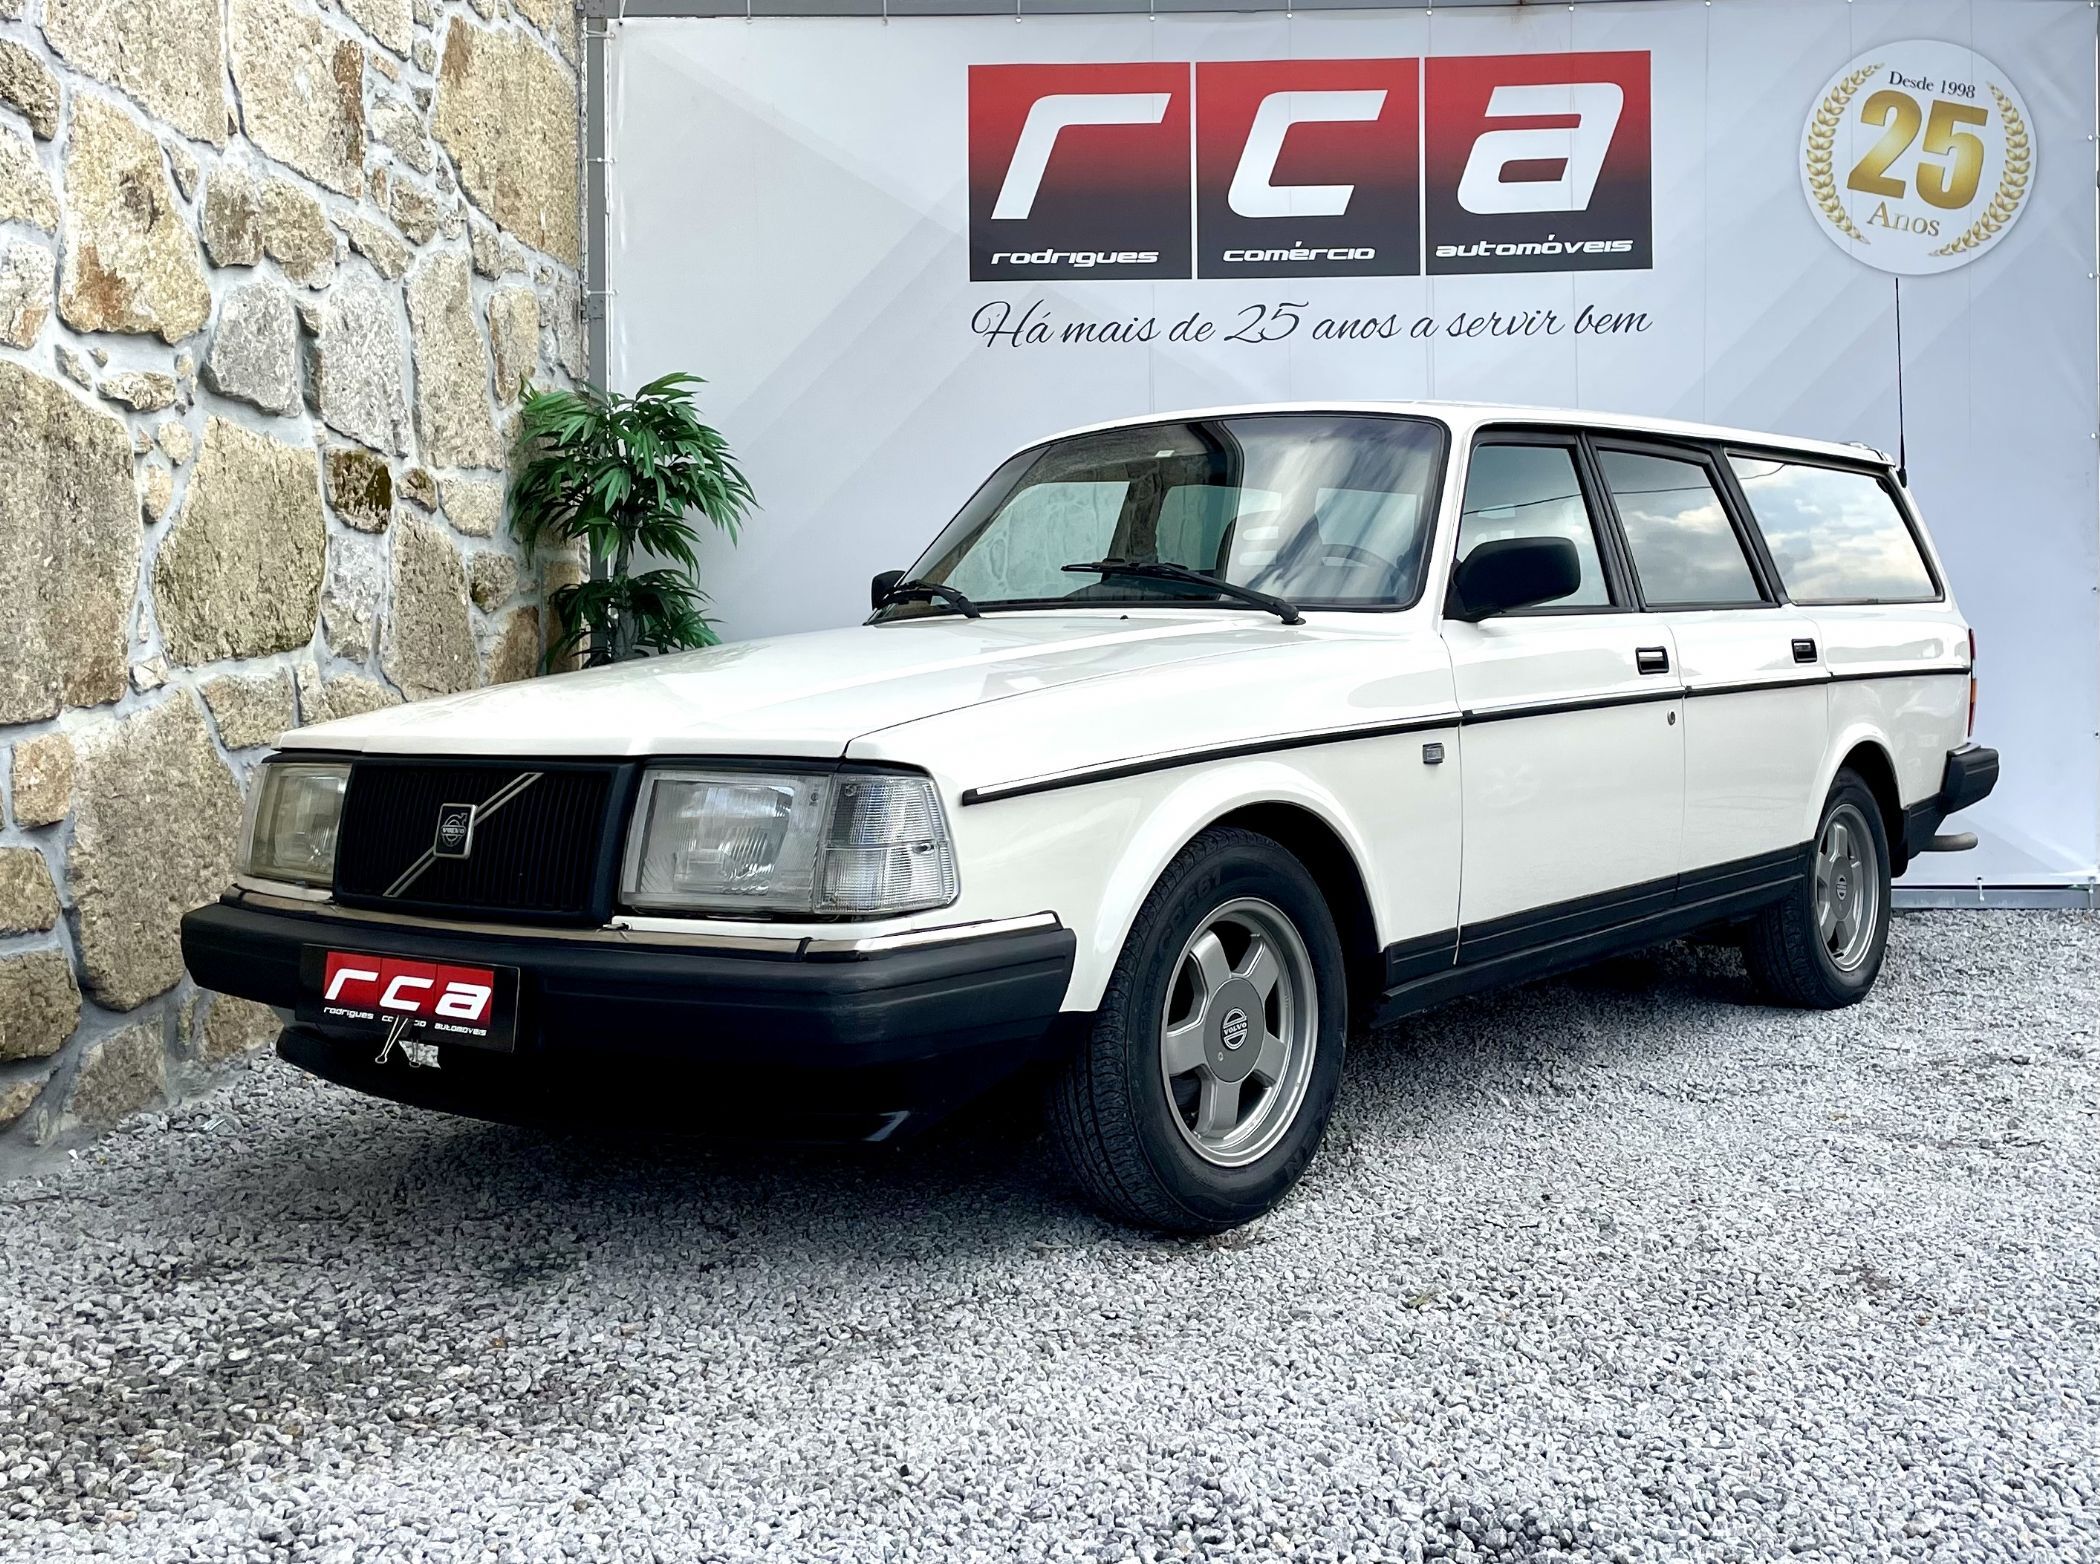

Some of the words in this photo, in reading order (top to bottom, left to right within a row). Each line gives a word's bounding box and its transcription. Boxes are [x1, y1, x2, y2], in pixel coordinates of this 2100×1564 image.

[1888, 71, 1934, 92] Desde
[1940, 80, 1976, 99] 1998
[1846, 89, 1989, 210] 25
[1866, 200, 1941, 237] Anos
[990, 248, 1160, 268] rodrigues
[1222, 240, 1376, 262] comércio
[1435, 234, 1634, 258] automóveis
[971, 298, 1054, 349] Há
[1060, 316, 1162, 344] mais
[1168, 312, 1216, 343] de
[1223, 300, 1309, 344] 25
[1312, 313, 1402, 340] anos
[1410, 316, 1440, 339] a
[1445, 309, 1566, 338] servir
[1573, 303, 1654, 336] bem
[1223, 1022, 1248, 1036] VOLVO
